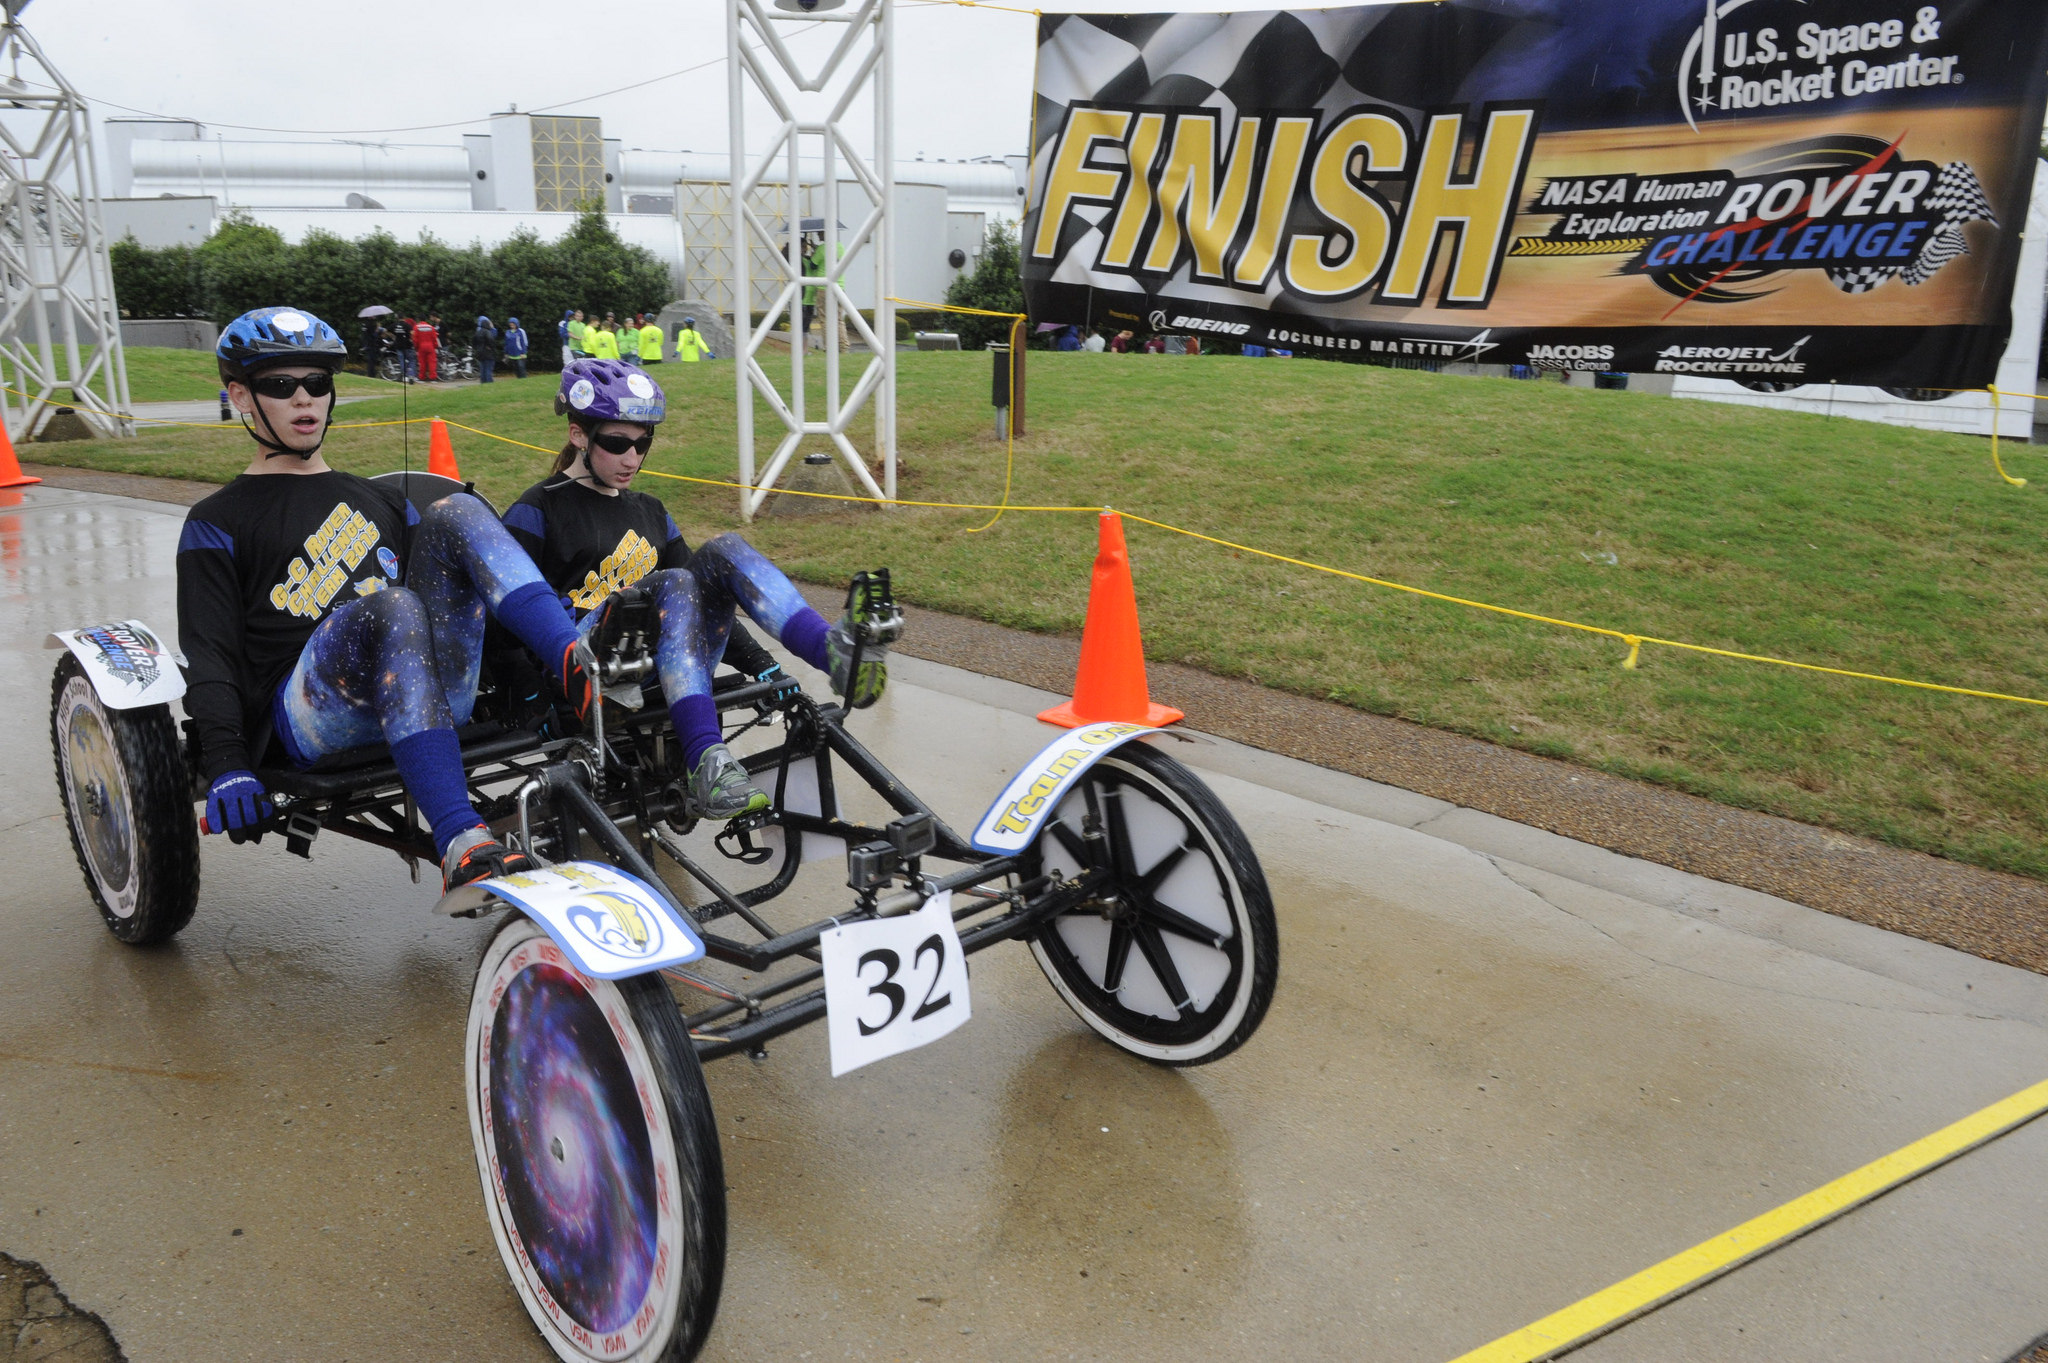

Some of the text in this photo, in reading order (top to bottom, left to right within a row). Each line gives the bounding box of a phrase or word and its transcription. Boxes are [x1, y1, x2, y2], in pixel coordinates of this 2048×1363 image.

[1723, 6, 1942, 68] U.S. Space &
[1720, 65, 1836, 110] Rocket
[1031, 106, 1536, 304] FINISH
[1541, 177, 1727, 206] NASA Human
[1714, 170, 1931, 224] ROVER
[1562, 208, 1710, 240] Exploration
[1645, 221, 1928, 267] CHALLENGE
[1171, 315, 1251, 335] BOEING
[1267, 328, 1454, 356] LOCKHEED MARTIN
[1526, 344, 1615, 360] JACOBS
[1574, 360, 1611, 372] Group
[1654, 359, 1806, 374] ROCKETDYNE
[1656, 345, 1773, 359] AEROJET
[270, 557, 309, 610] G-C
[303, 502, 353, 563] ROVER
[287, 510, 368, 617] CHALLENGE
[302, 565, 349, 620] TEAM
[342, 520, 380, 572] 2015
[600, 529, 640, 579] ROVER
[623, 546, 658, 587] 2015
[993, 749, 1093, 834] Team
[856, 933, 951, 1037] 32
[537, 1280, 561, 1320] NASA
[569, 1321, 593, 1350] NASA
[601, 1334, 627, 1354] NASA
